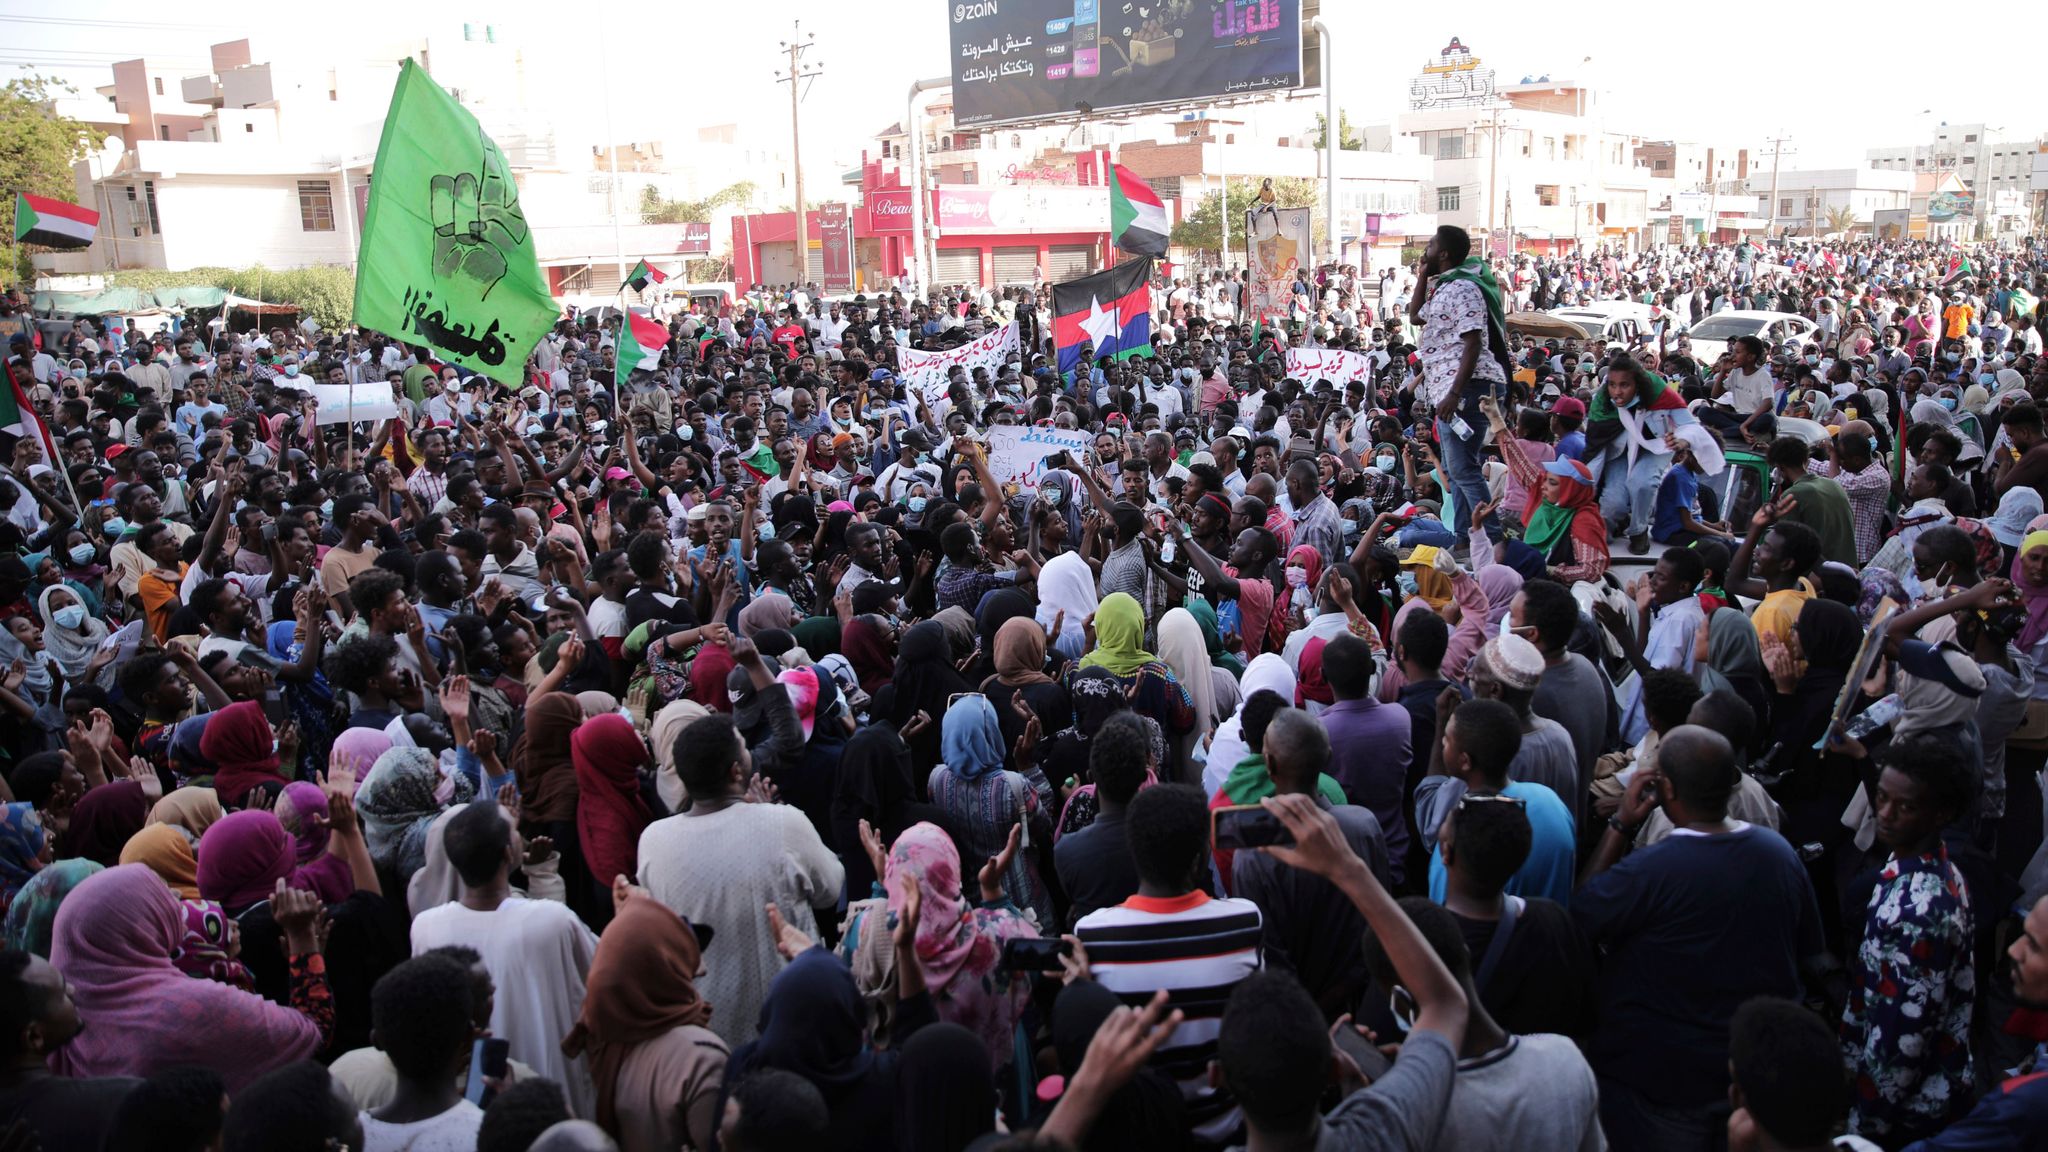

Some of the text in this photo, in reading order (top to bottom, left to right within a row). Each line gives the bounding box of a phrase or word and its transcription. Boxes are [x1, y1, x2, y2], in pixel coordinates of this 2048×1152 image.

[962, 33, 1032, 59] عيش المرونة
[962, 60, 1034, 83] وتكتكا براحتك
[1225, 81, 1248, 91] جميل
[1020, 427, 1082, 453] يسقط
